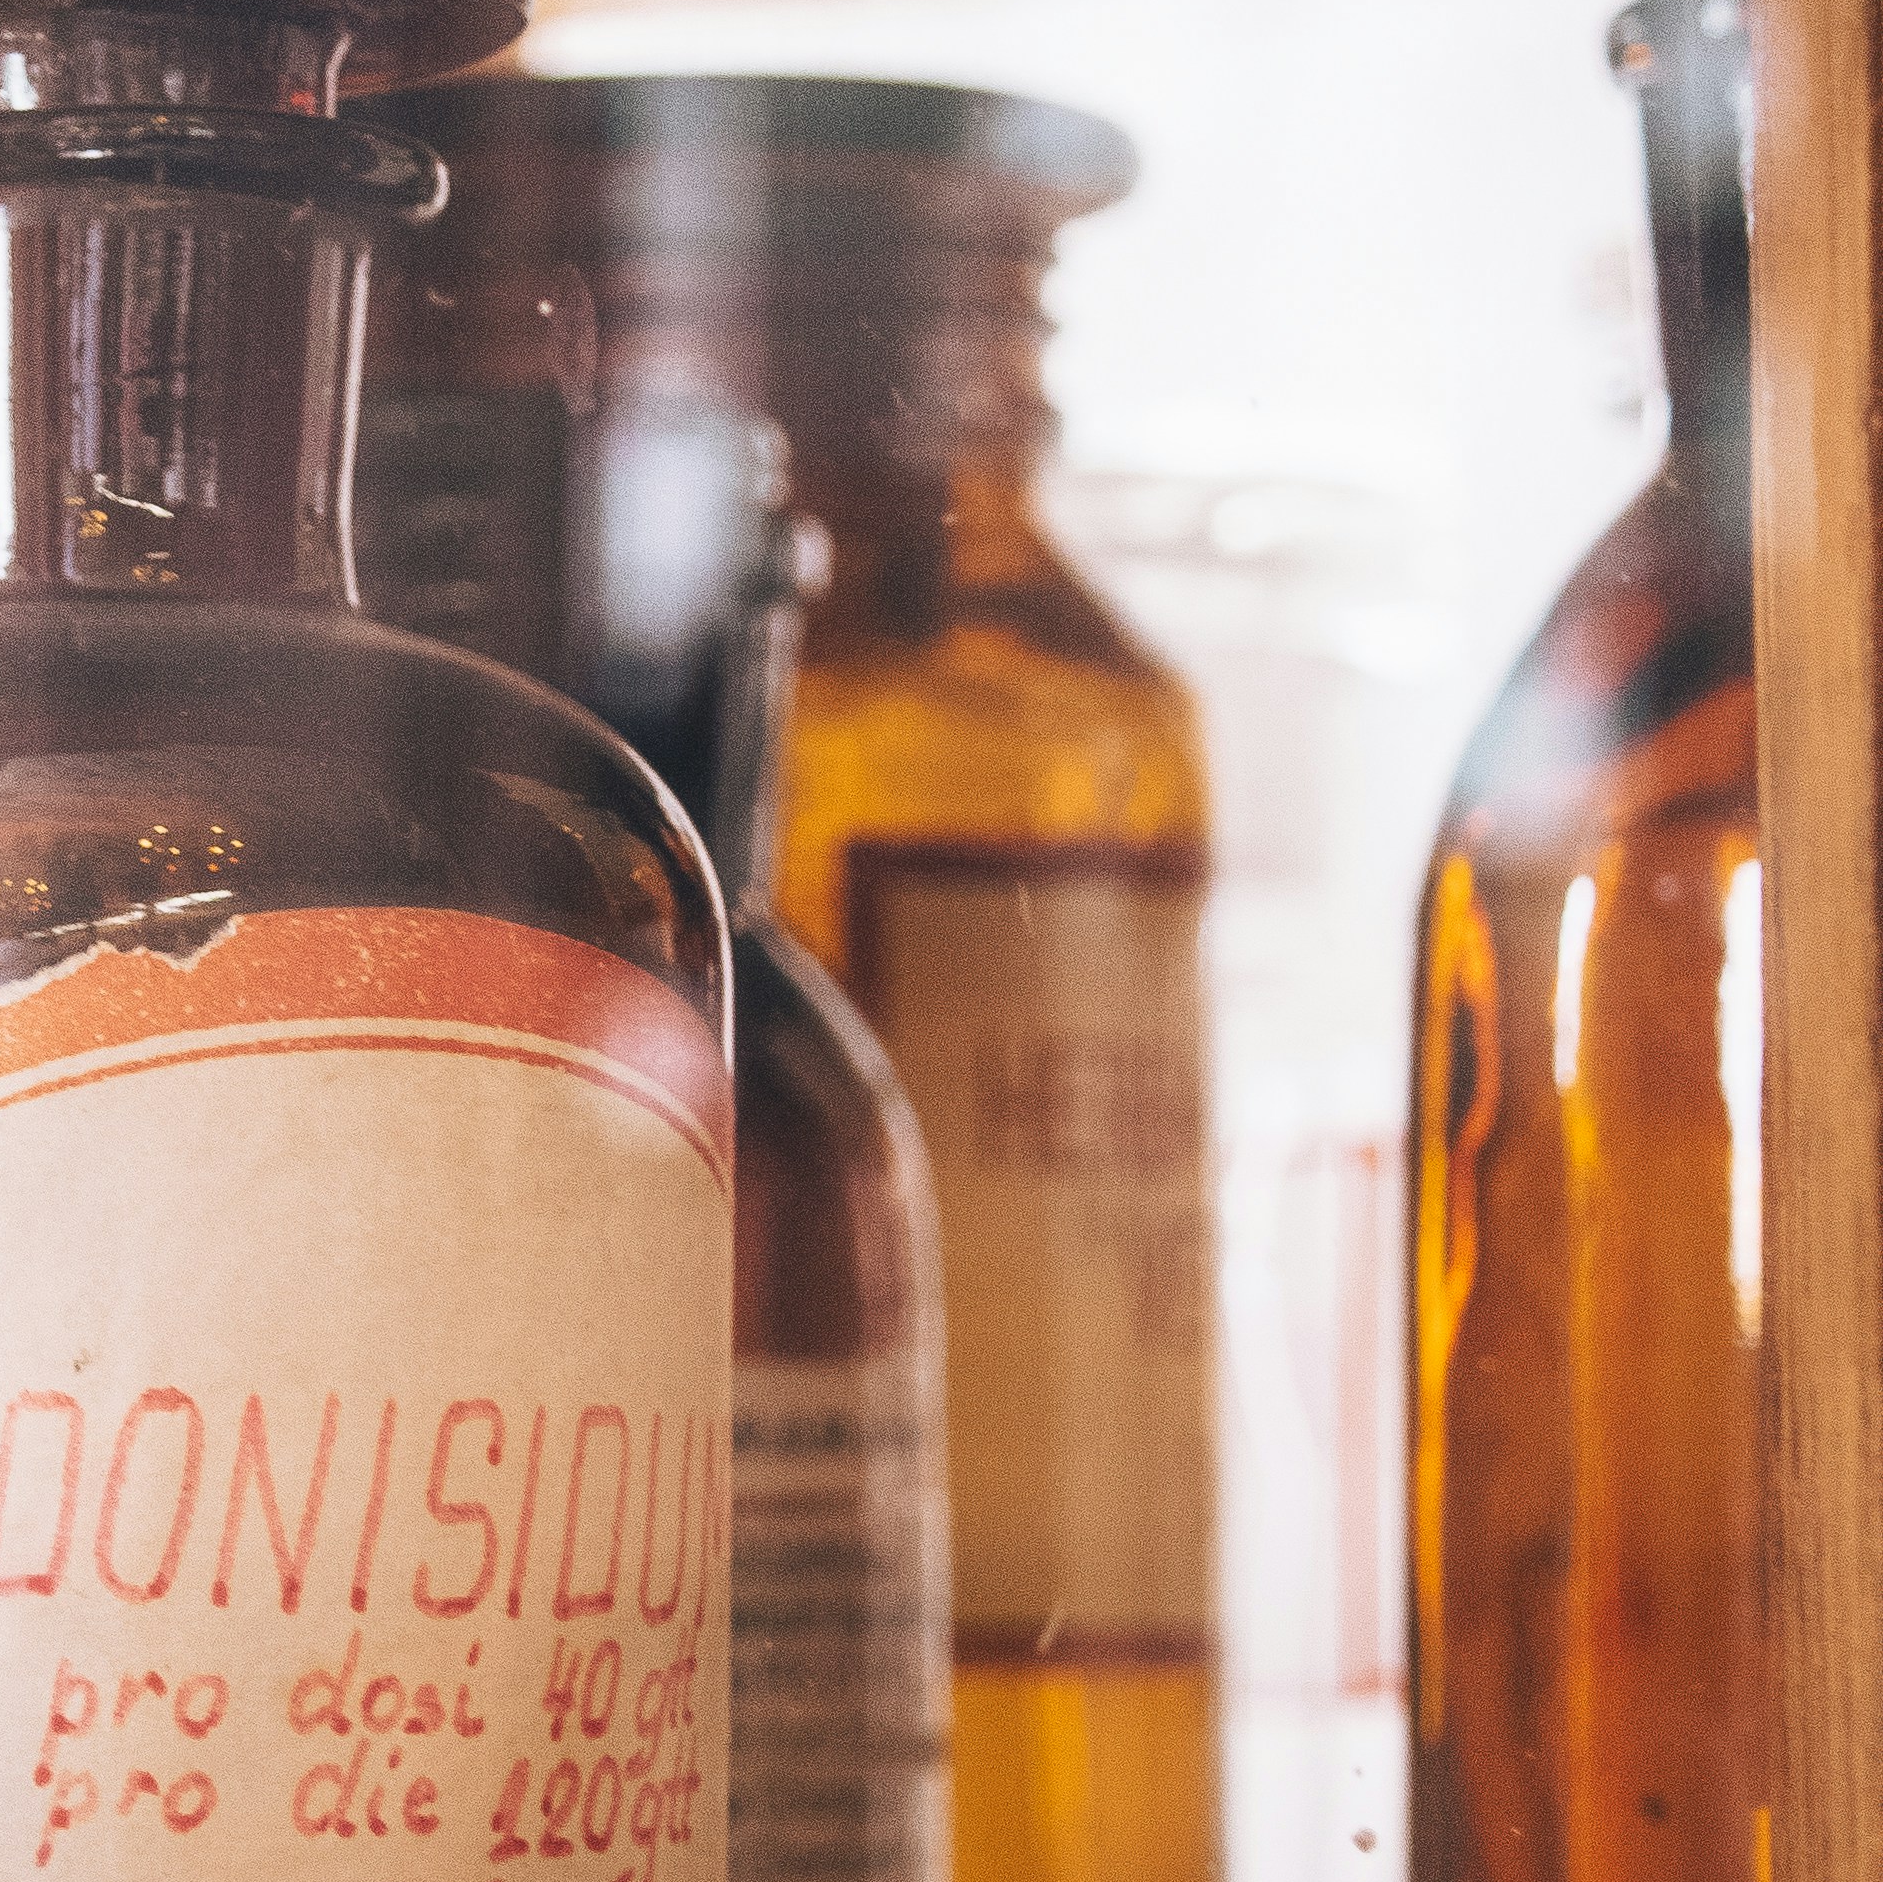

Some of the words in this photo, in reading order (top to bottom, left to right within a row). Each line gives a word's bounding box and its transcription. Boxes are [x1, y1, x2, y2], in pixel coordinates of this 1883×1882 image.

[35, 1658, 229, 1787] pro
[287, 1629, 486, 1739] dosi
[35, 1765, 219, 1867] pro
[292, 1738, 441, 1838] die
